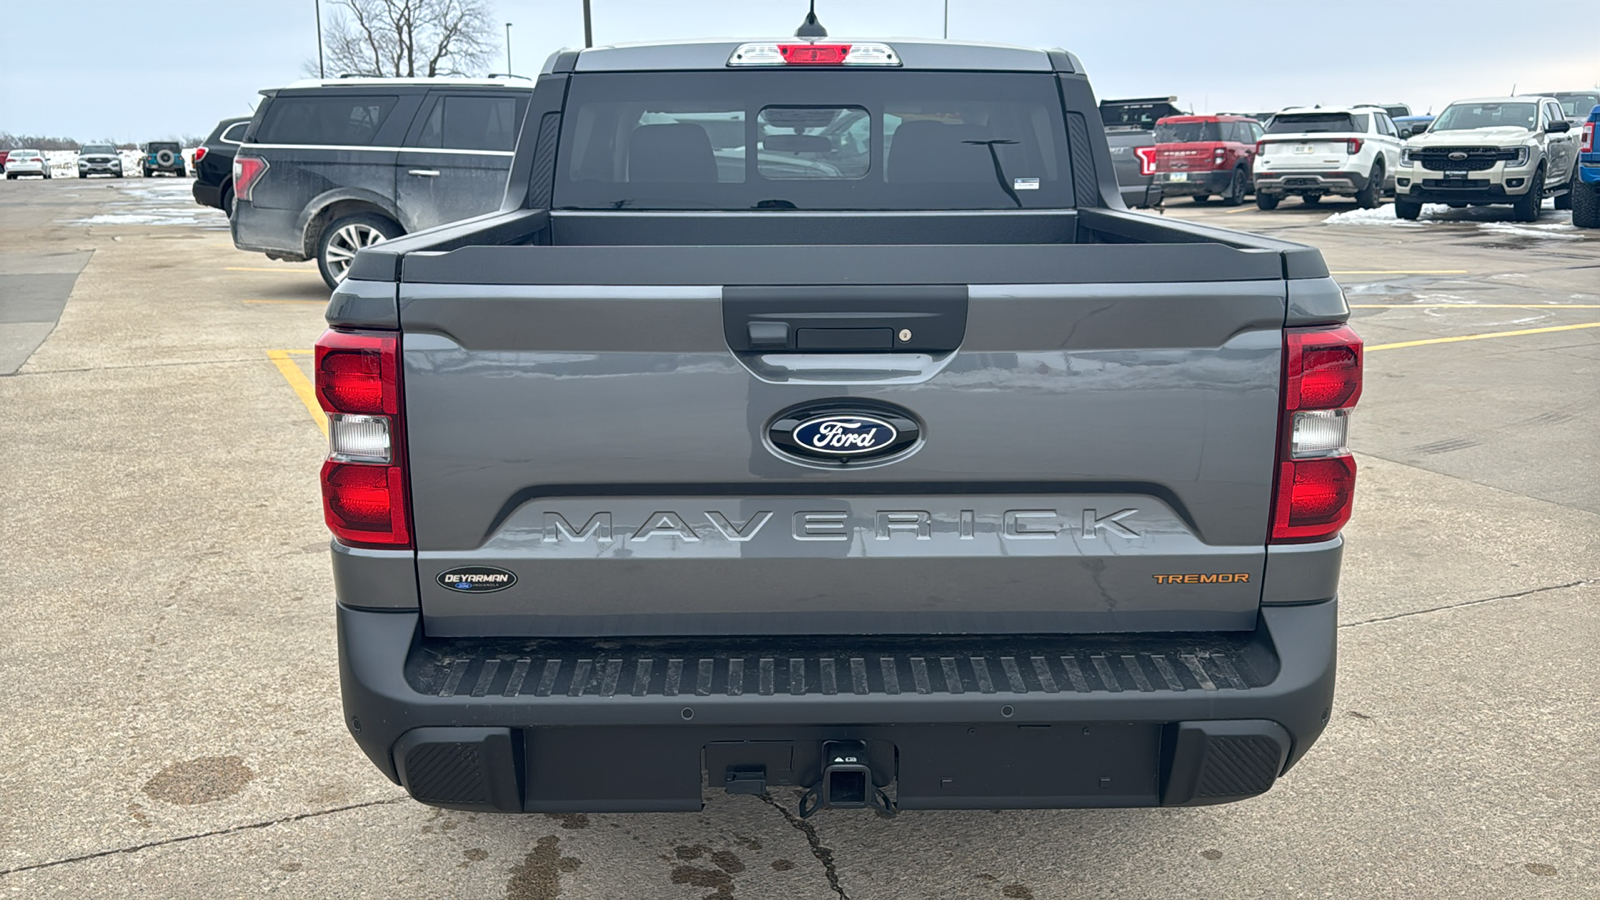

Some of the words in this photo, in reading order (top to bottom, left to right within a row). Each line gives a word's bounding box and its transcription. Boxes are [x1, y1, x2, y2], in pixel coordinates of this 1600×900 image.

[813, 421, 877, 447] Ford
[542, 507, 1142, 542] MAVERICK
[444, 574, 509, 583] DEYARMAN
[1152, 572, 1250, 584] TREMOR
